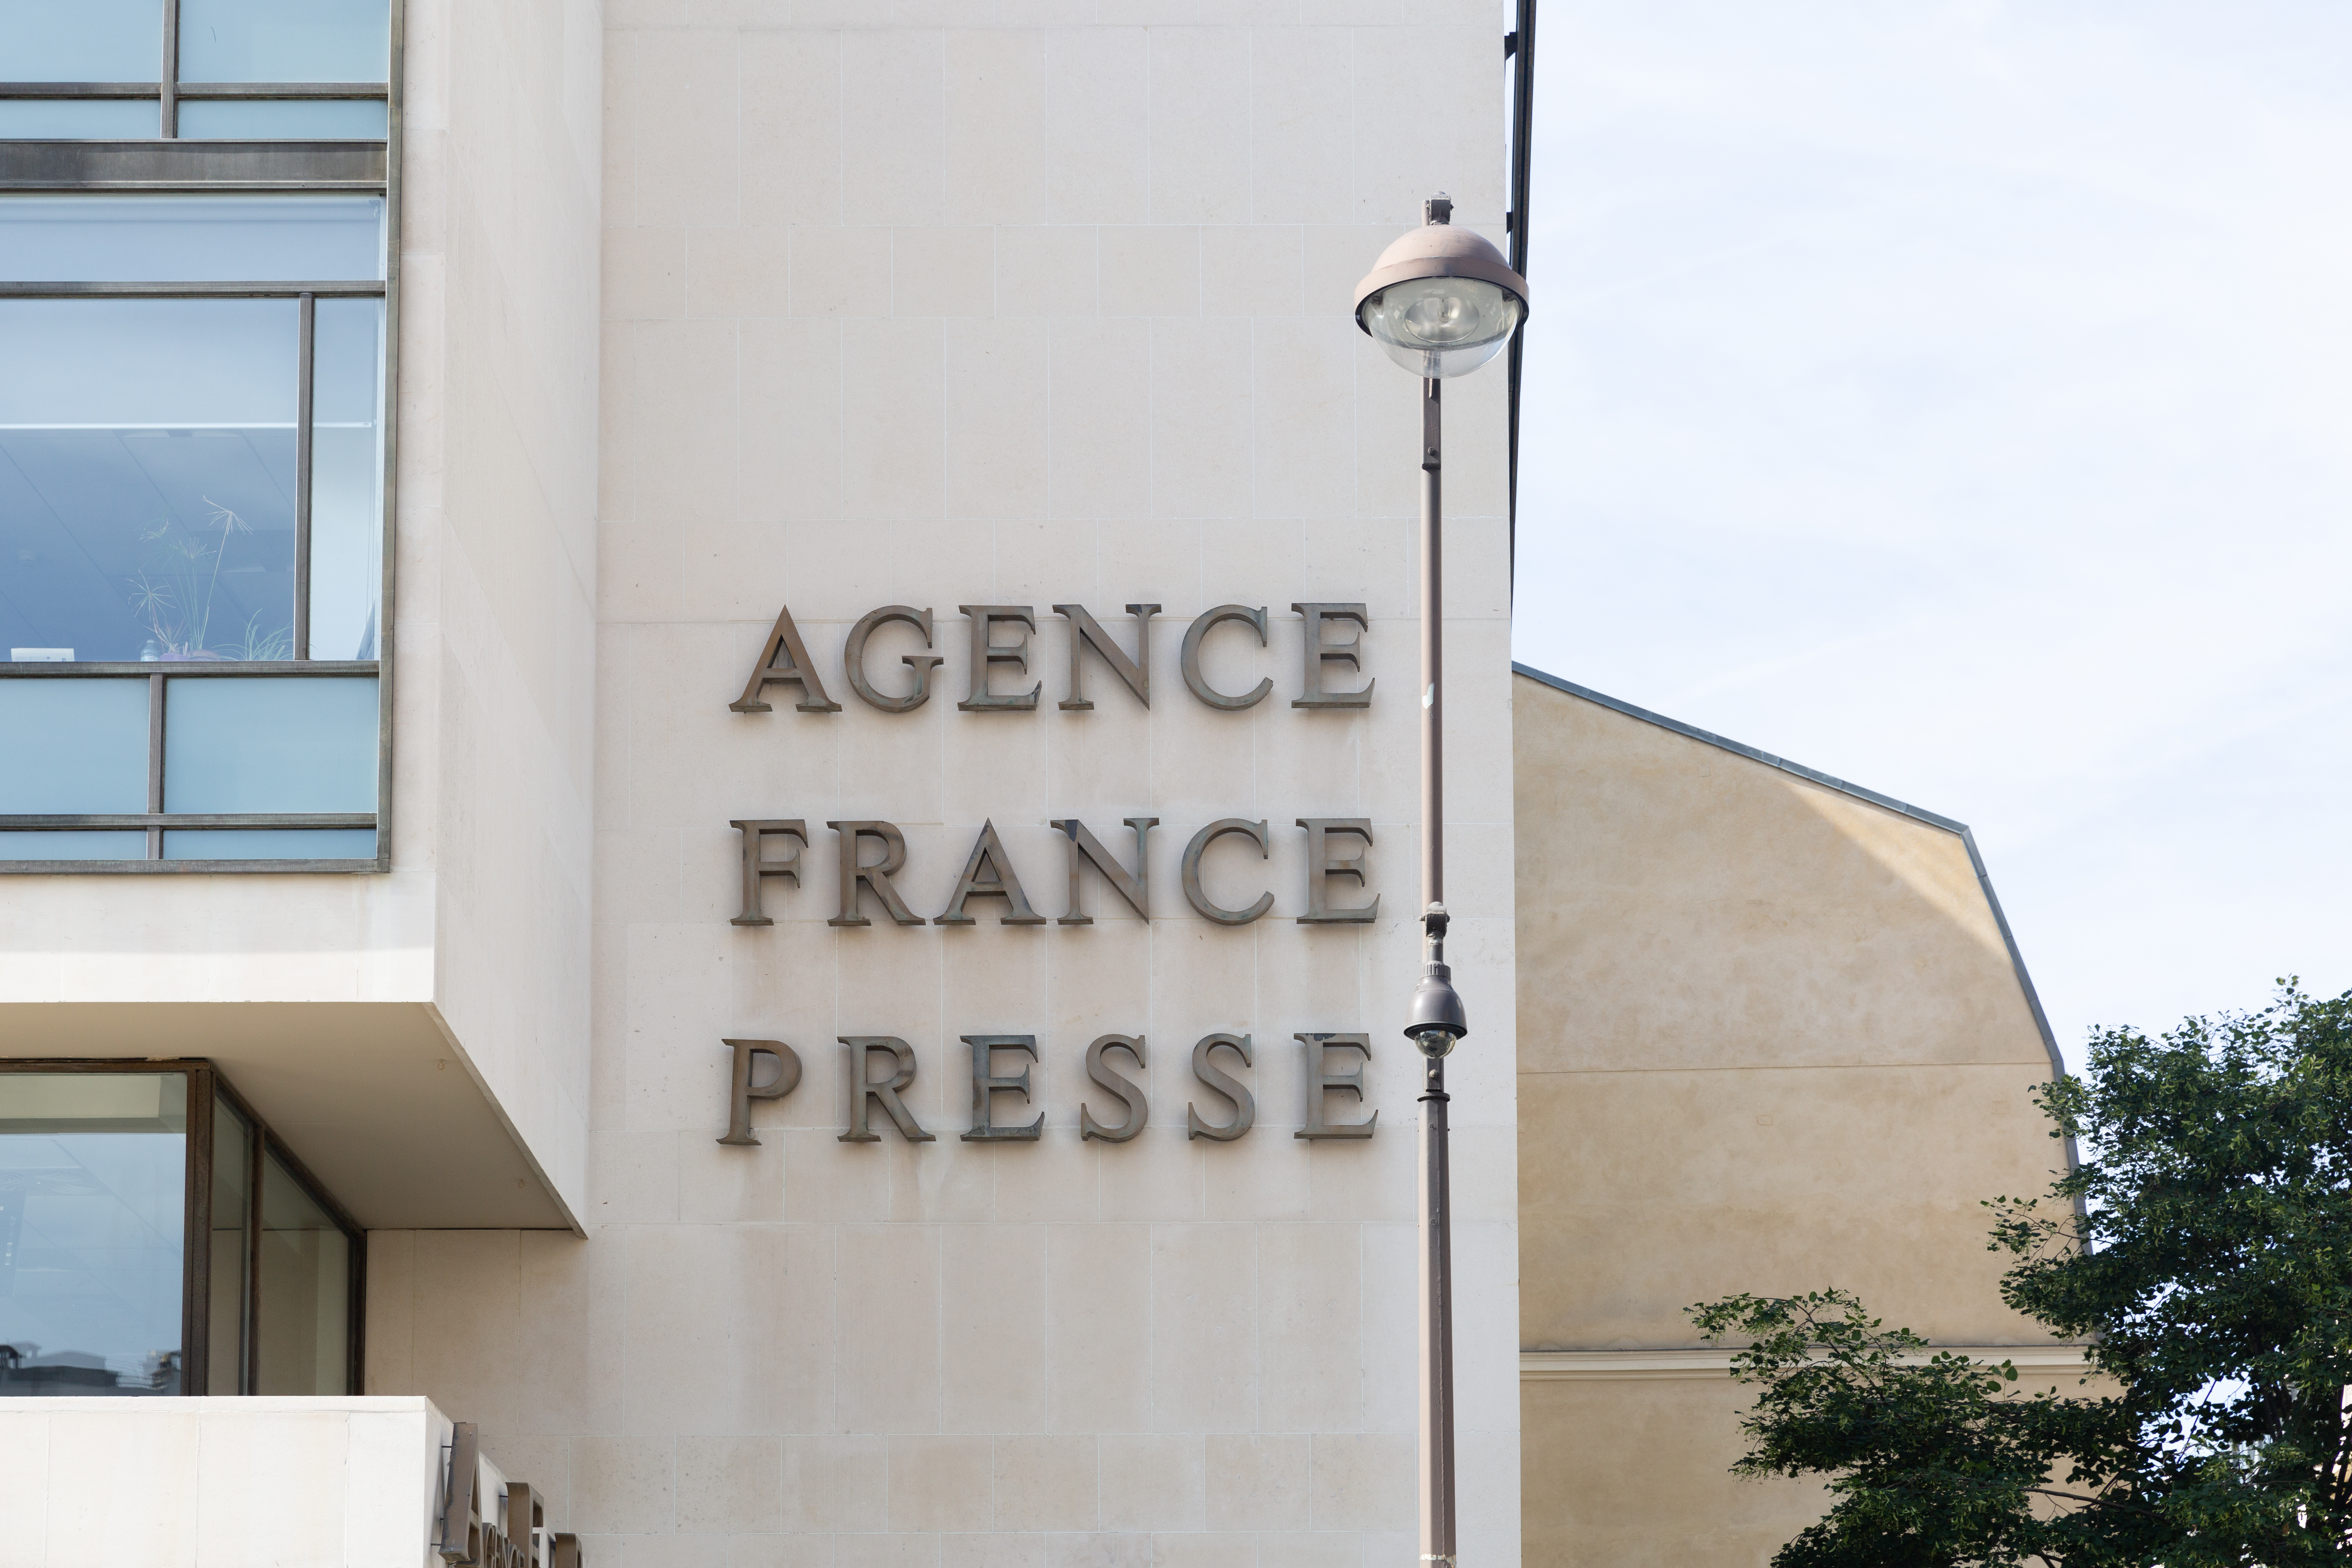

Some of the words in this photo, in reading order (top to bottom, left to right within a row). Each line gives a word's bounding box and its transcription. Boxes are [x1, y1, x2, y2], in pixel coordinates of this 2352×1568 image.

[728, 603, 1375, 713] AGENCE
[729, 817, 1380, 926] FRANCE
[715, 1033, 1378, 1146] PRESSE
